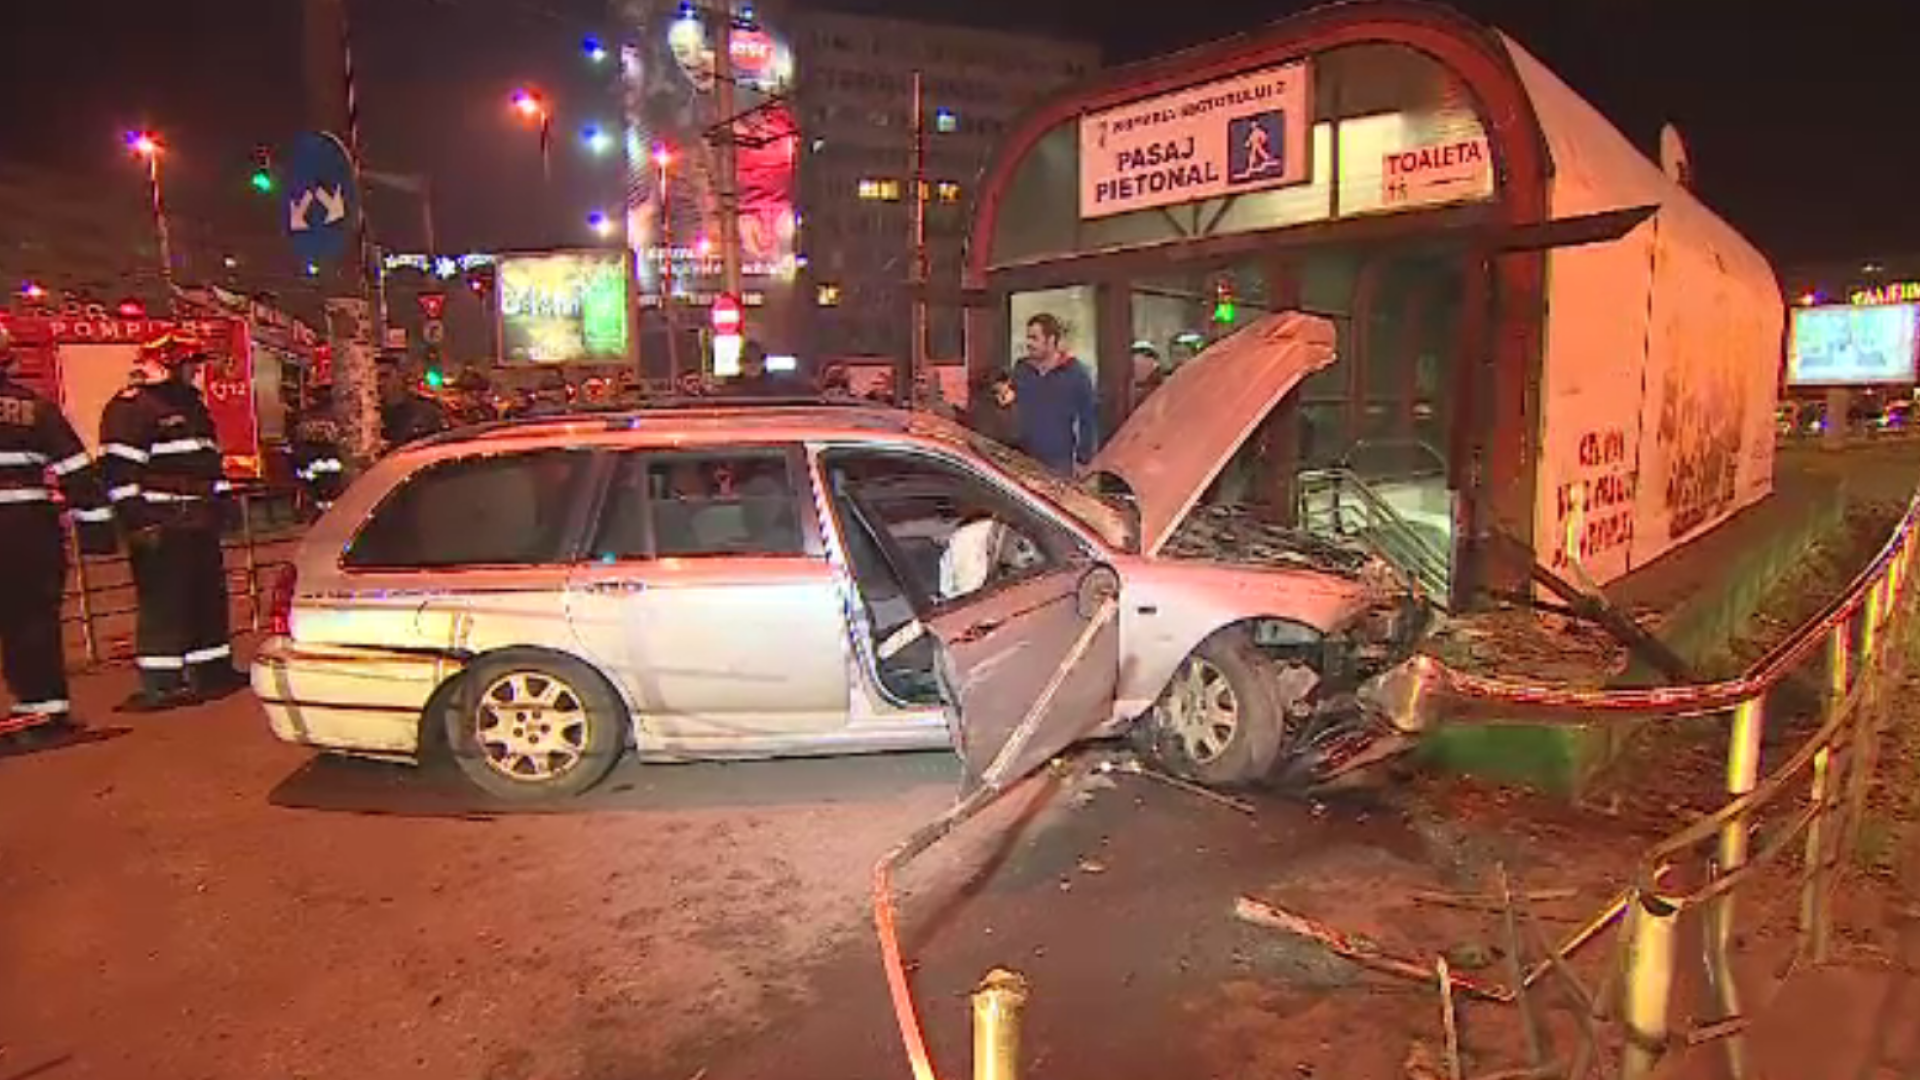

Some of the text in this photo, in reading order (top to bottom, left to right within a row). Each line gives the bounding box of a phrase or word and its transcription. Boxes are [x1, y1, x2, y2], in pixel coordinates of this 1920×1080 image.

[1116, 136, 1195, 172] PASAJ
[1387, 140, 1482, 175] TOALETA
[1095, 161, 1219, 203] PIETONAL
